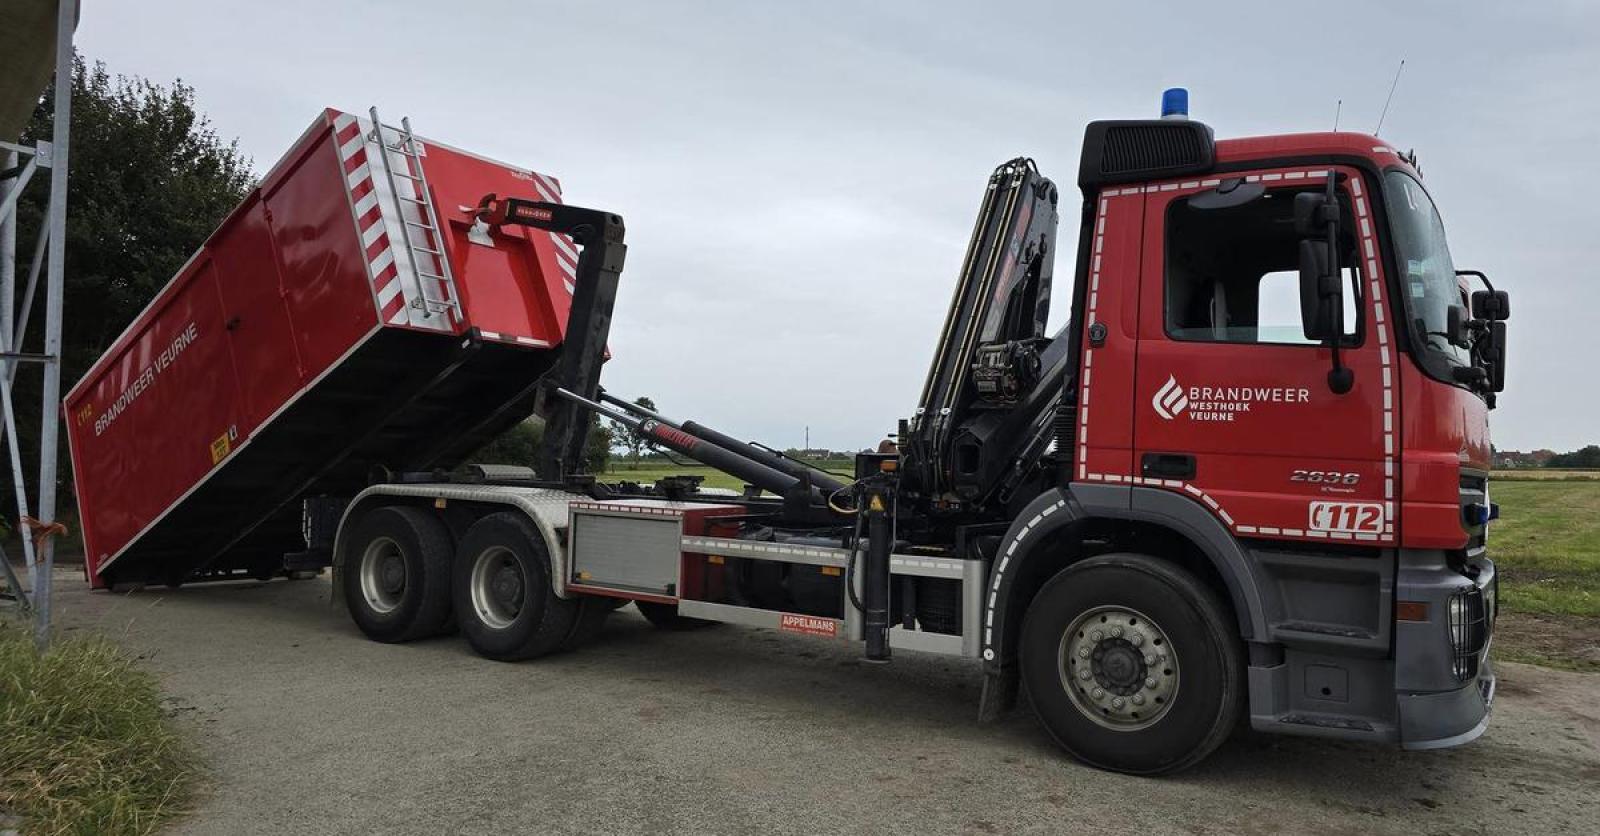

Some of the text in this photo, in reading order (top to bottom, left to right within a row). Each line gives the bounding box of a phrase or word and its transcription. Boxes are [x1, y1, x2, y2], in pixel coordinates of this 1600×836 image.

[95, 322, 199, 436] BRANDWEER VEURNE
[1189, 387, 1310, 403] BRANDWEER
[1189, 401, 1251, 412] WESTHOEK
[1189, 411, 1234, 421] VEURNE
[783, 615, 834, 631] APPELMANS
